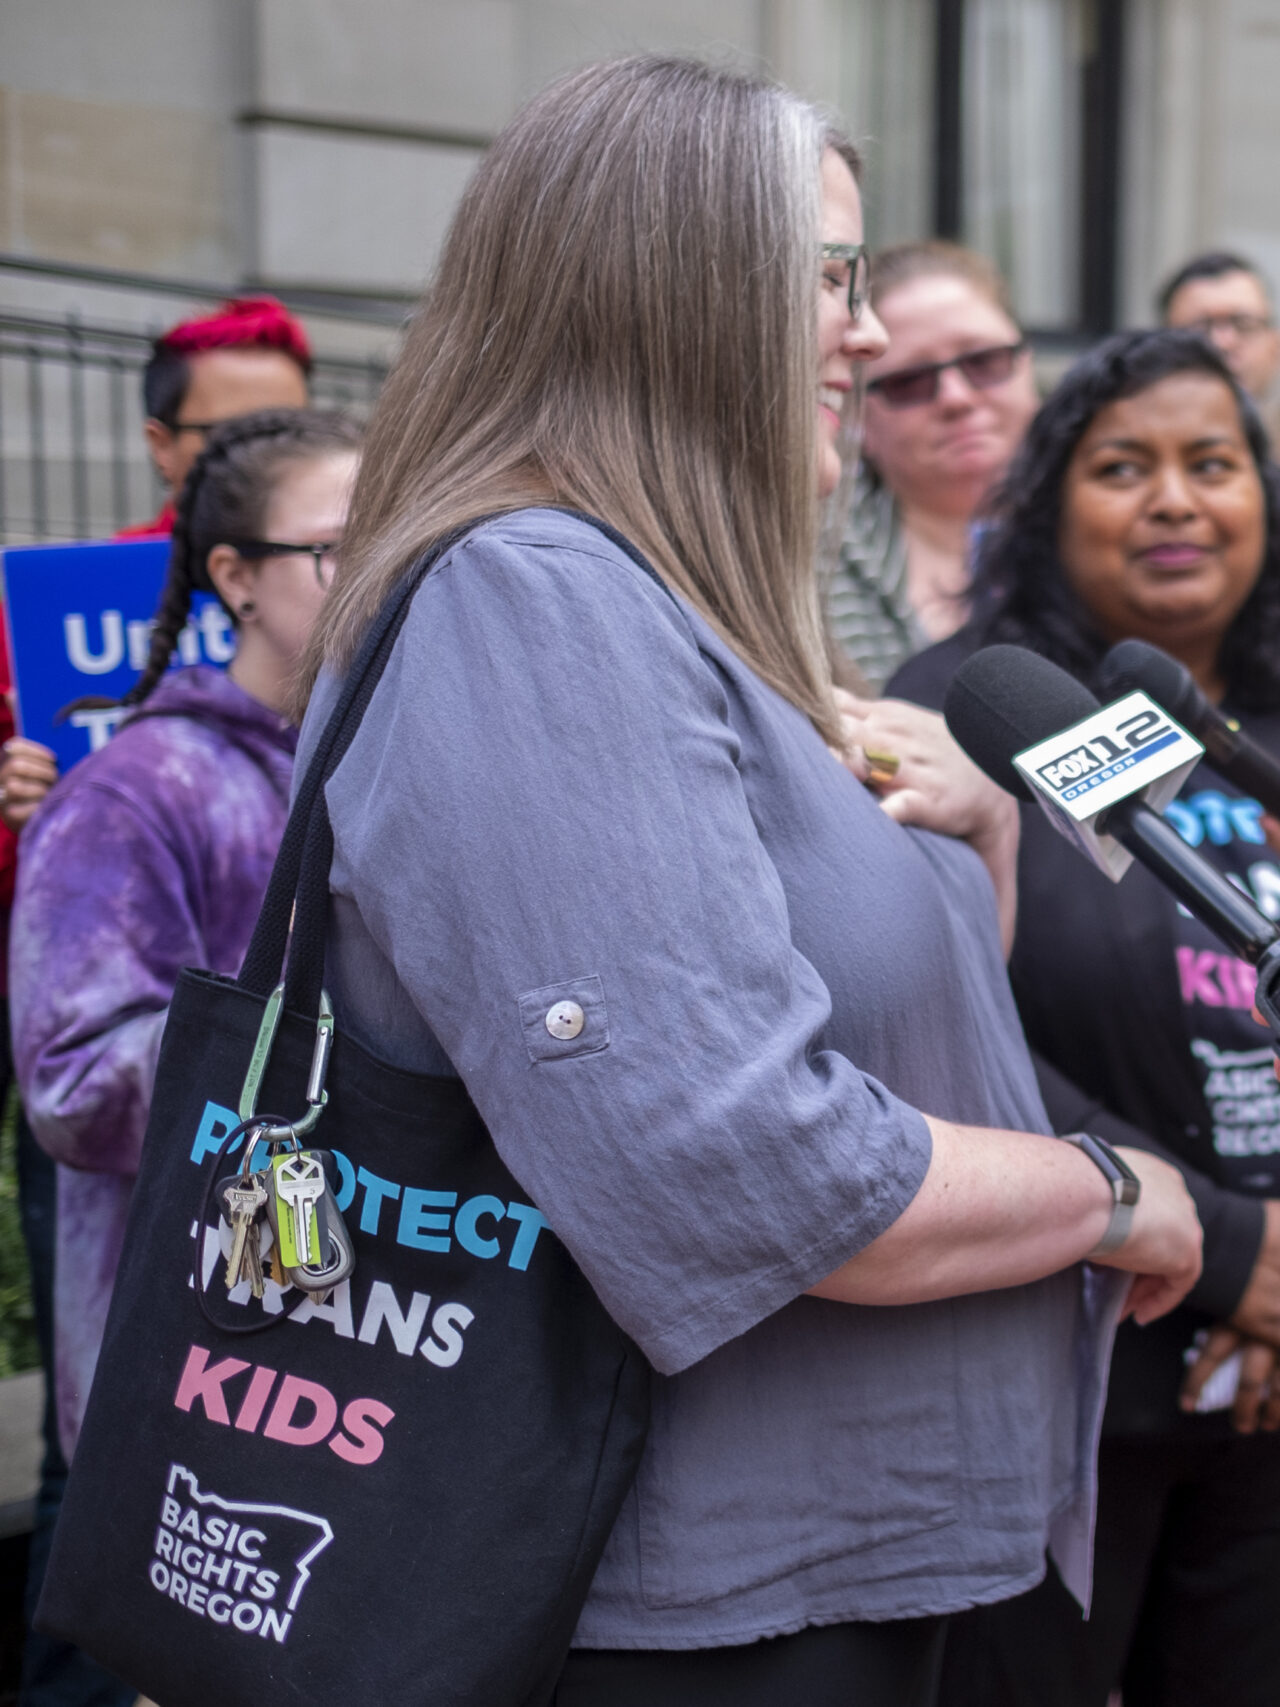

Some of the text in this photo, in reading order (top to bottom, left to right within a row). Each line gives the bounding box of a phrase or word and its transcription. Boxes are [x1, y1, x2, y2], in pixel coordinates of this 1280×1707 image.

[1041, 710, 1172, 788] FOX 12
[1064, 757, 1137, 799] OREGON
[174, 1345, 396, 1465] KIDS
[155, 1527, 280, 1599] RIGHTS
[161, 1496, 267, 1558] BASIC
[150, 1562, 292, 1643] OREGON
